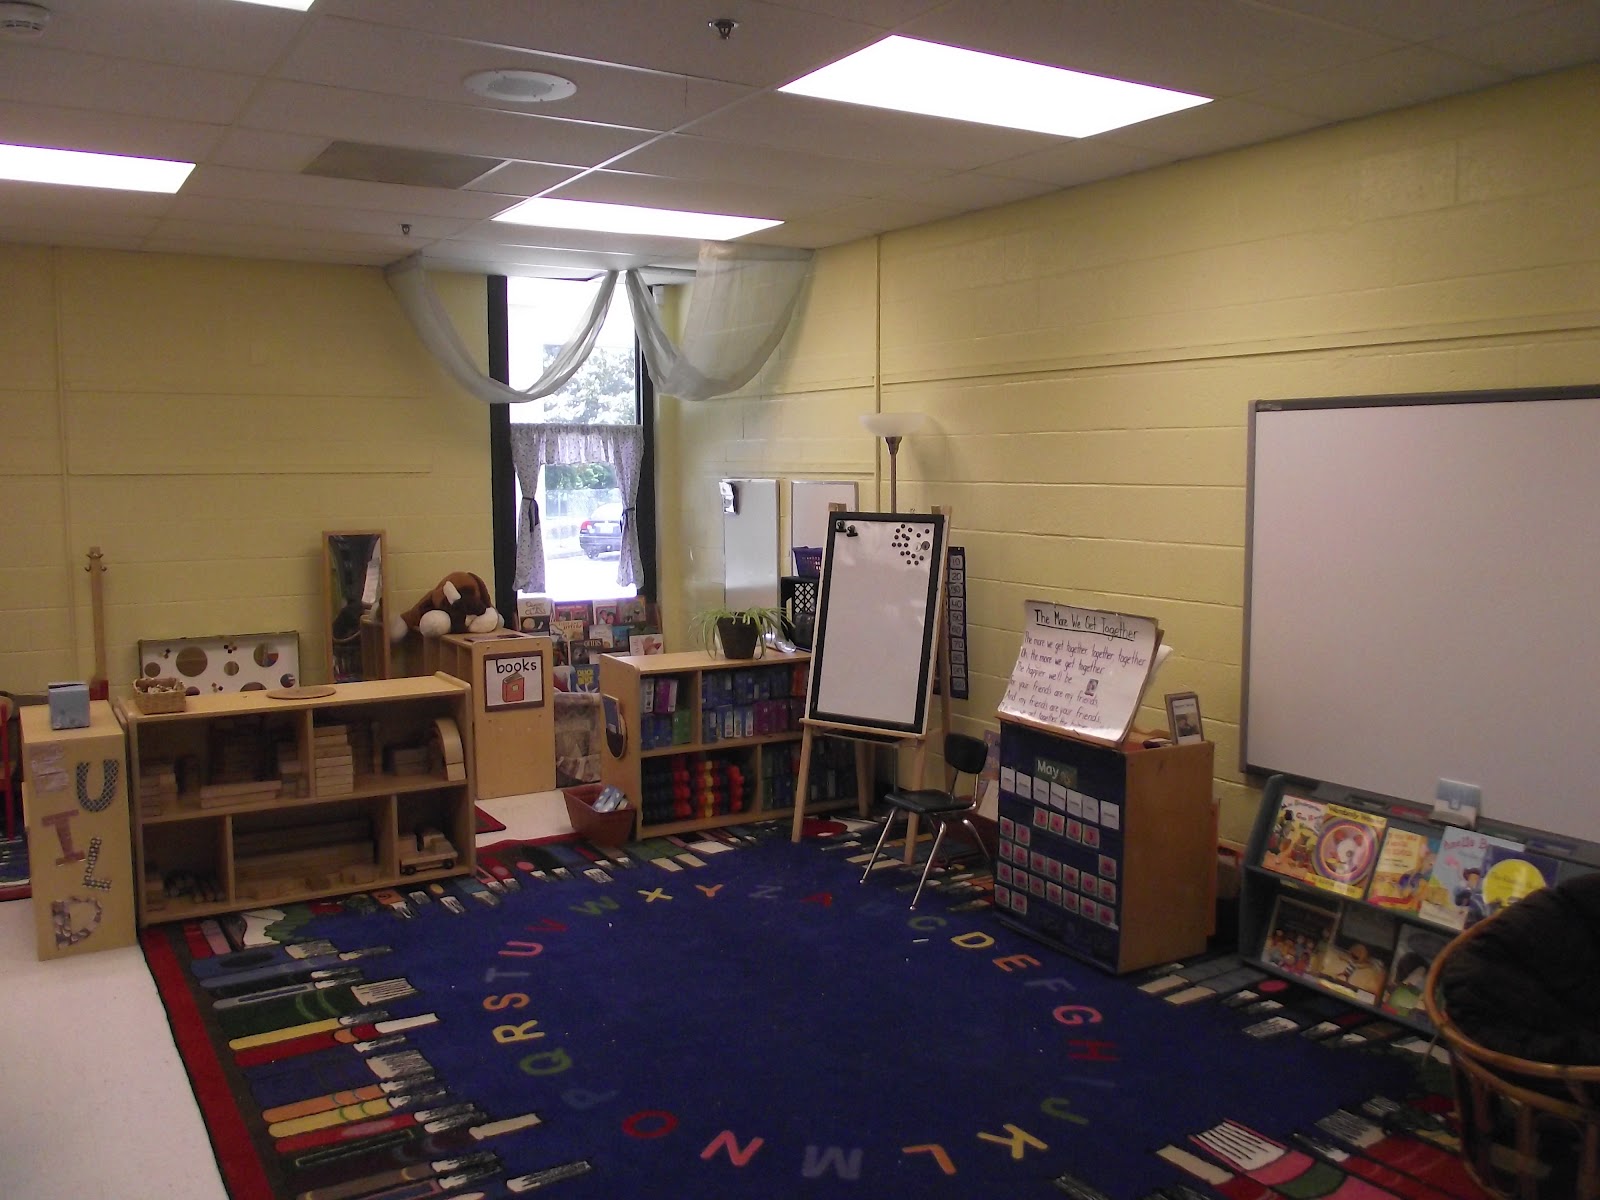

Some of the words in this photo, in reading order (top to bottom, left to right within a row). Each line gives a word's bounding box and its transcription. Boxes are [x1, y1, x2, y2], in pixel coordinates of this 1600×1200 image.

[952, 557, 961, 566] 10
[952, 572, 962, 582] 20
[951, 600, 962, 609] 40
[952, 613, 962, 622] 50
[1034, 609, 1050, 624] The
[1054, 611, 1068, 626] More
[1072, 614, 1081, 629] We
[1085, 616, 1096, 630] Get
[1102, 617, 1139, 641] Together
[953, 640, 964, 649] 70
[1034, 638, 1045, 646] more
[1055, 641, 1064, 653] get
[495, 658, 537, 674] books
[1040, 655, 1052, 663] more
[1055, 658, 1062, 666] we
[1065, 660, 1075, 670] get
[1026, 664, 1045, 678] happier
[1064, 674, 1072, 684] be
[1032, 681, 1052, 695] friends
[1064, 692, 1073, 702] my
[1019, 697, 1026, 706] my
[1029, 696, 1048, 710] friends
[1037, 759, 1060, 779] May
[637, 888, 673, 902] X
[695, 884, 724, 897] Y
[908, 915, 947, 931] C
[951, 931, 995, 948] D
[498, 940, 543, 956] U
[992, 954, 1041, 972] E
[483, 992, 530, 1011] S
[1053, 1005, 1102, 1025] G
[492, 1019, 545, 1043] R
[519, 1048, 572, 1076] Q
[621, 1110, 679, 1138] O
[977, 1123, 1048, 1159] K
[902, 1144, 957, 1175] L
